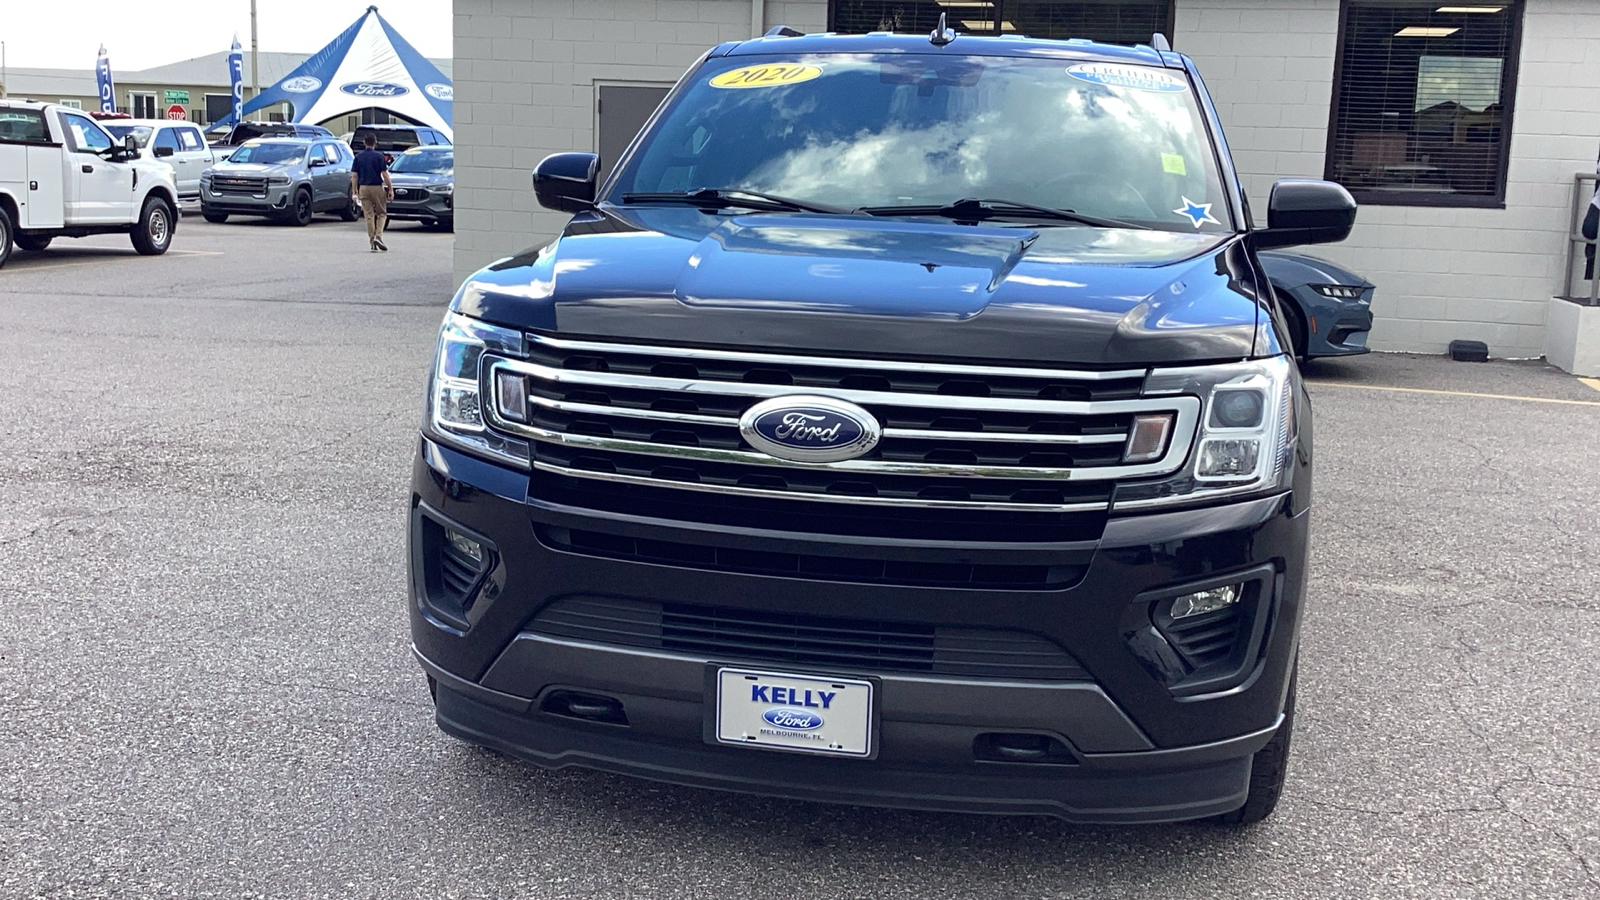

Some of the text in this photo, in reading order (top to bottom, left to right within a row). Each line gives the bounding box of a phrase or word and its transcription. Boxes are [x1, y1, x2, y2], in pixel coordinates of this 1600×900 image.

[723, 66, 807, 86] 2020
[353, 82, 396, 96] Ford
[168, 111, 186, 120] STOP
[774, 412, 842, 443] Ford
[751, 684, 837, 709] KELLY
[773, 709, 812, 728] Ford
[760, 728, 811, 739] MELBOURNE,
